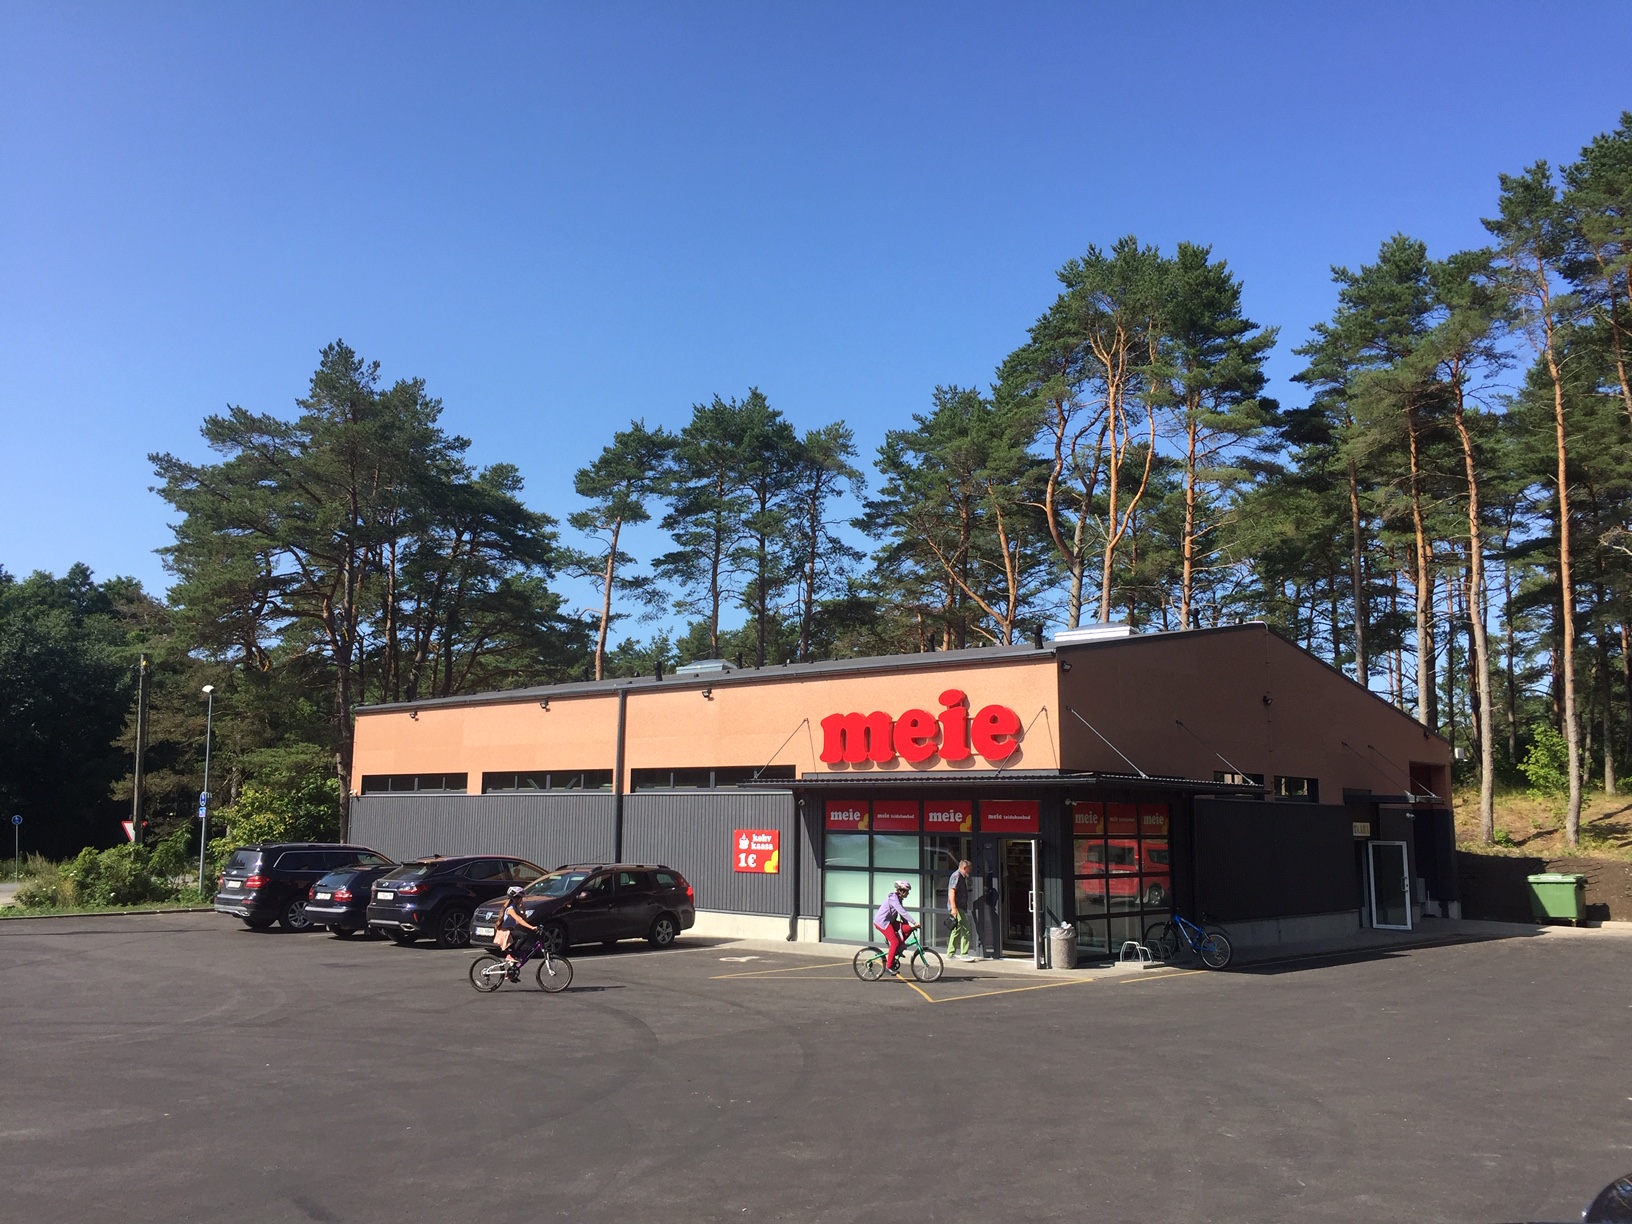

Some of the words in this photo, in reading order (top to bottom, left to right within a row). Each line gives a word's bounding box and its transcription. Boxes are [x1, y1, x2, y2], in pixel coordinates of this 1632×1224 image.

[819, 689, 1022, 763] meie
[830, 809, 861, 821] meie
[928, 810, 963, 822] meie
[1075, 811, 1098, 824] meie
[1143, 813, 1164, 825] meie
[738, 853, 757, 868] 1€
